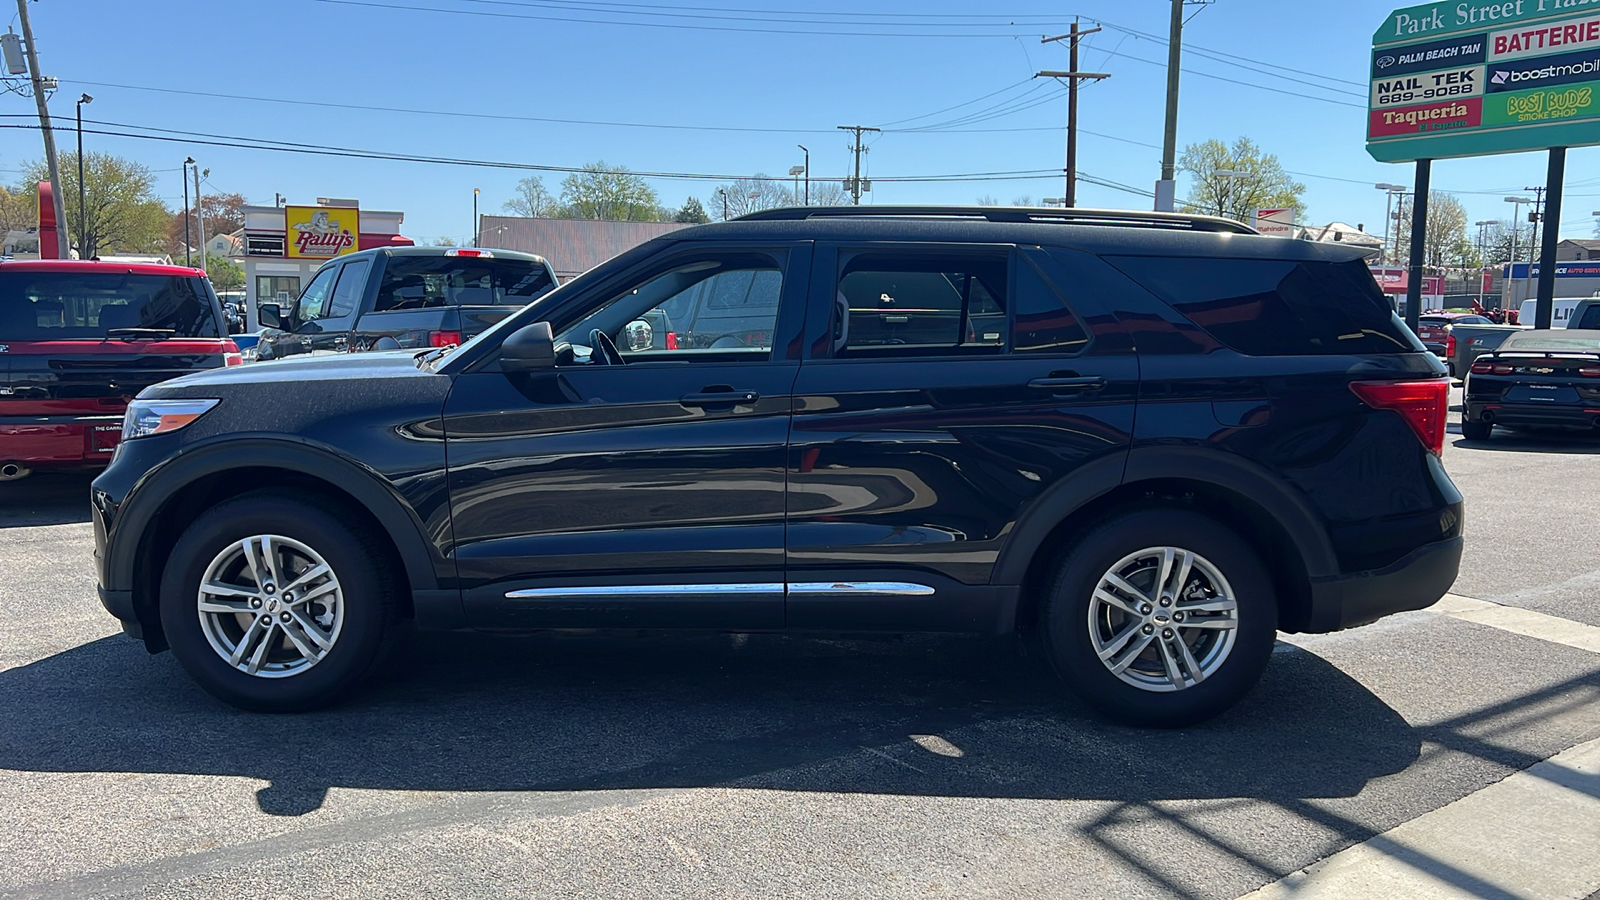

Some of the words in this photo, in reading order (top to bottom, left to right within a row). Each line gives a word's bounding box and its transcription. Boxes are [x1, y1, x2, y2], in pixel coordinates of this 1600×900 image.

[1395, 7, 1445, 36] Park
[1456, 0, 1524, 25] Street
[1398, 52, 1425, 64] PALM
[1426, 46, 1459, 61] BEACH
[1461, 43, 1481, 55] TAN
[1378, 78, 1422, 94] NAIL
[1432, 69, 1475, 86] TEK
[1379, 84, 1473, 104] 689-9088
[1518, 111, 1550, 122] SMOKE
[1551, 108, 1577, 118] SHOP
[294, 229, 354, 254] Rally's
